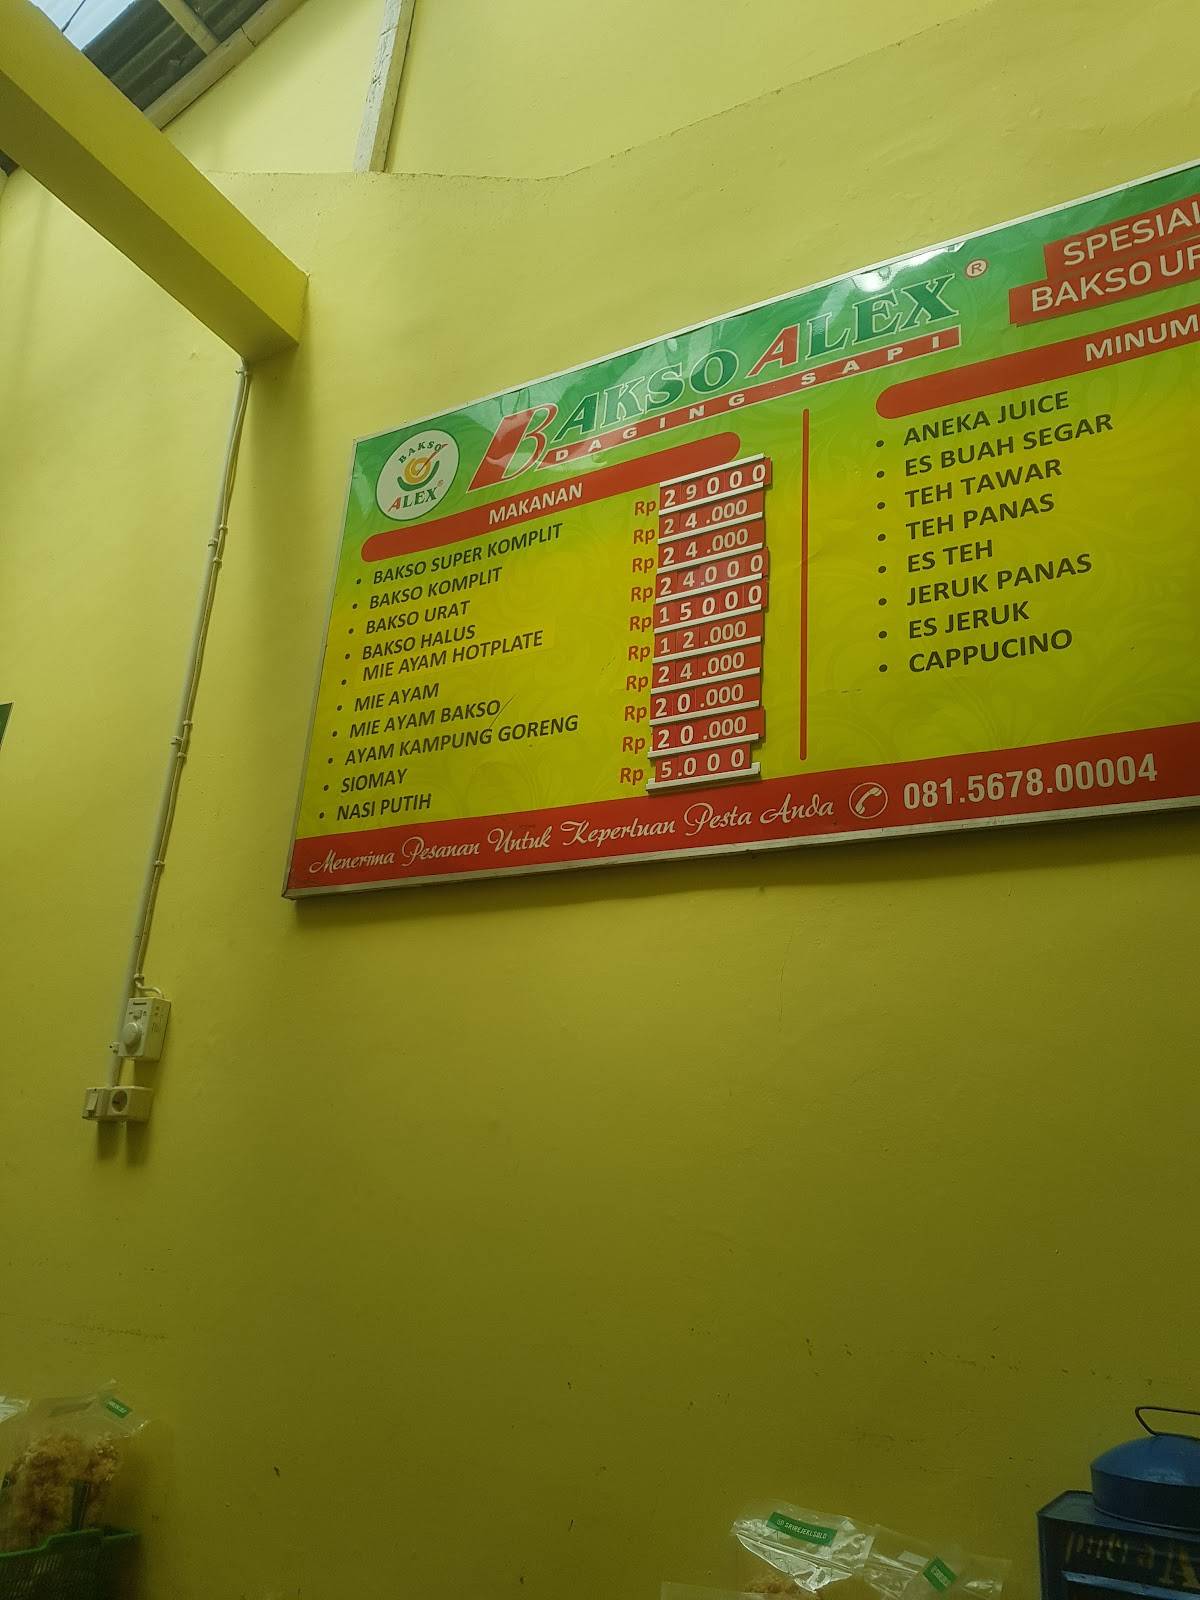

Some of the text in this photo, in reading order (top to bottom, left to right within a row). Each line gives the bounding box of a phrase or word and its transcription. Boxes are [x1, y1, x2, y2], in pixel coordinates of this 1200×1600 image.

[1031, 260, 1152, 312] BAKSO
[1085, 313, 1199, 362] MINUM
[467, 348, 739, 493] BAKSO
[744, 273, 960, 379] ALEX
[555, 336, 940, 462] DAGING SAPI
[904, 391, 1069, 446] ANEKA JUICE
[398, 441, 441, 463] BAKSO
[905, 413, 1113, 477] ES BUAH SEGAR
[388, 487, 437, 512] ALEX
[905, 459, 1062, 508] TEH TAWAR
[488, 483, 583, 525] MAKANAN
[634, 500, 656, 516] Rp
[906, 493, 1055, 540] TEH PANAS
[373, 523, 563, 584] BAKSO SUPER KOMPLIT
[633, 529, 655, 545] Rp
[632, 557, 654, 573] Rp
[908, 539, 993, 573] ES TEH
[369, 567, 502, 609] BAKSO KOMPLIT
[631, 587, 653, 603] Rp
[907, 553, 1092, 606] JERUK PANAS
[366, 600, 471, 634] BAKSO URAT
[629, 616, 651, 632] Rp
[909, 600, 1029, 639] ES JERUK
[362, 625, 476, 660] BAKSO HALUS
[362, 630, 543, 682] MIE AYAM HOTPLATE
[628, 645, 650, 662] Rp
[909, 629, 1072, 673] CAPPUCINO
[354, 683, 440, 712] MIE AYAM
[626, 675, 648, 692] Rp
[349, 699, 501, 739] MIE AYAM BAKSO
[624, 705, 647, 722] Rp
[344, 715, 579, 765] AYAM KAMPUNG GORENG
[622, 736, 645, 754] Rp
[341, 768, 408, 793] SIOMAY
[620, 767, 644, 785] Rp
[309, 753, 1158, 874] Menerima Pesanan Untuk Keperluan Pesta Anda 081.5678.00004
[336, 793, 432, 821] NASI PUTIH
